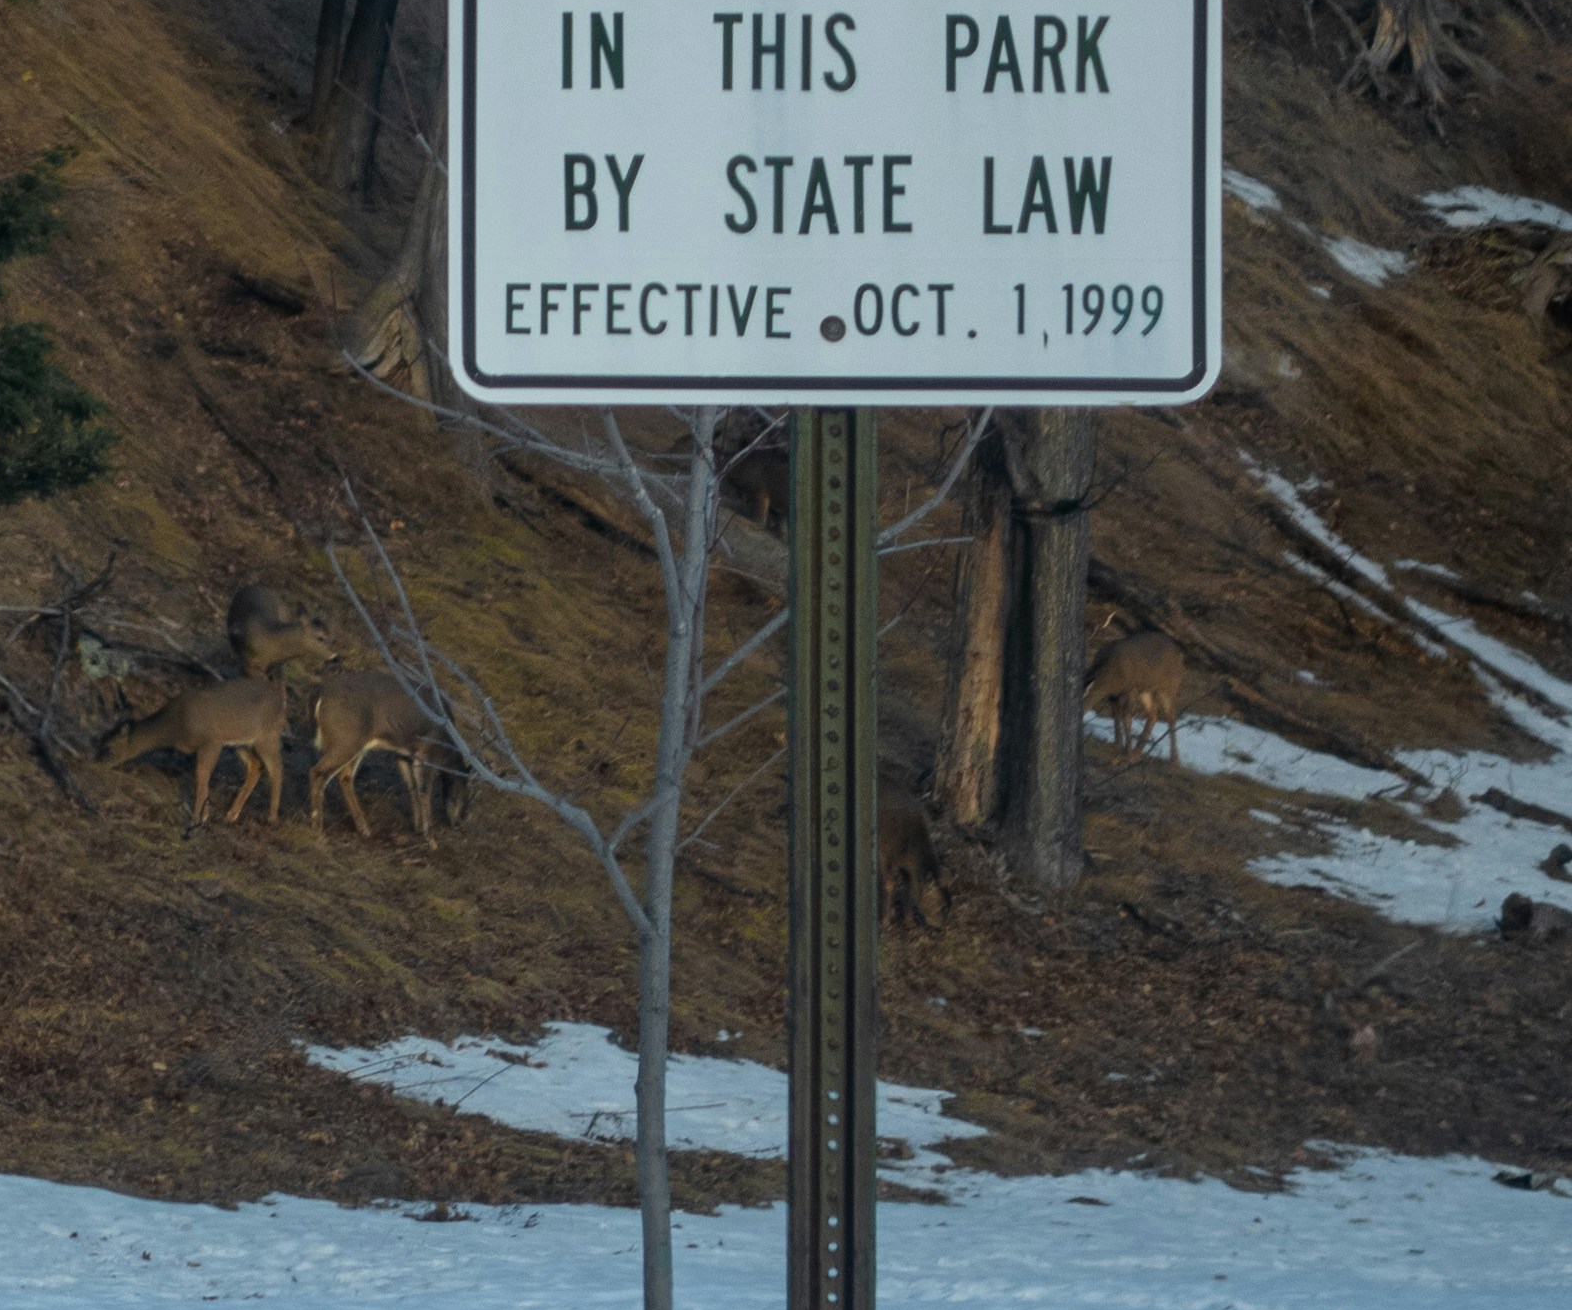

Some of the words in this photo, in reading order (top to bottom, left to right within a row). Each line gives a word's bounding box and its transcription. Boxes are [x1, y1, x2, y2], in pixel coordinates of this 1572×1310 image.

[562, 11, 625, 90] IN
[713, 12, 857, 93] THIS
[945, 14, 1110, 94] PARK
[563, 153, 645, 233] BY
[724, 154, 913, 235] STATE
[983, 155, 1113, 235] LAW
[505, 282, 792, 340] EFFECTIVE
[853, 283, 977, 339] OCT.
